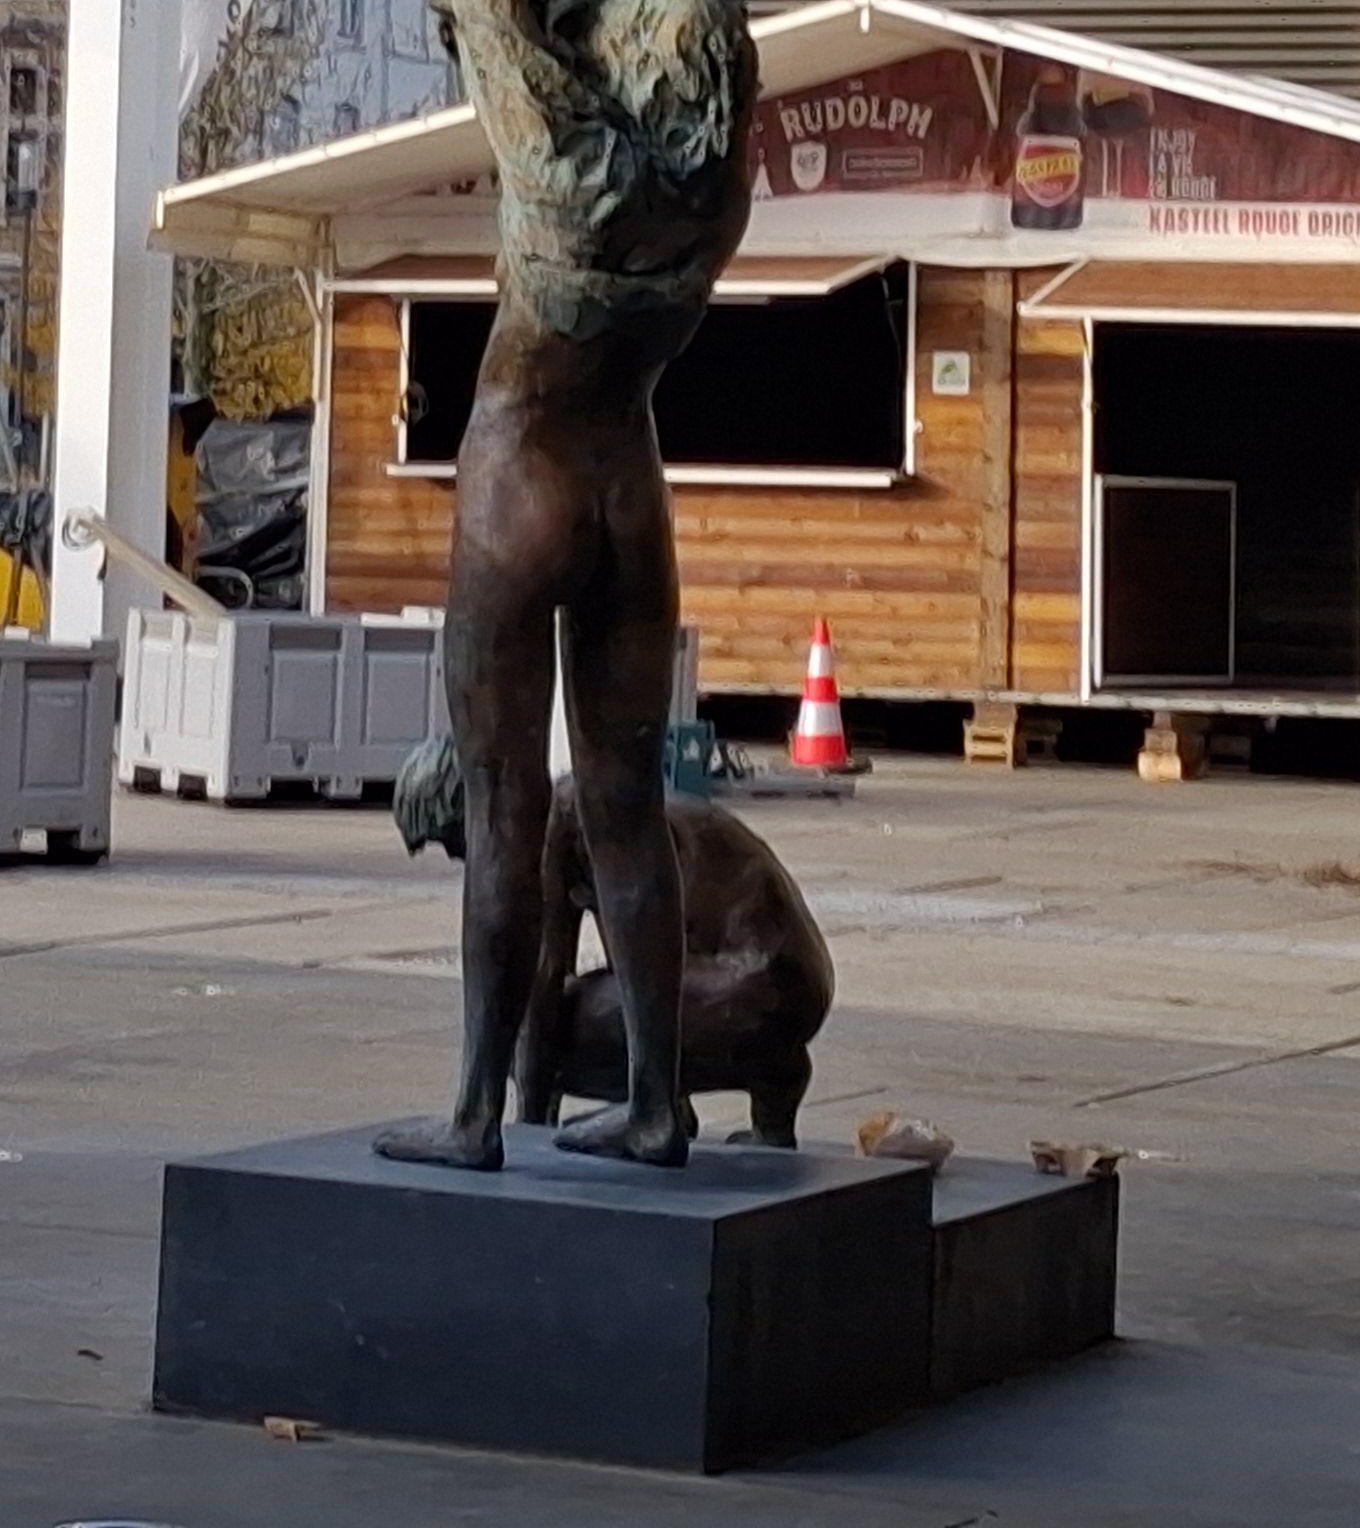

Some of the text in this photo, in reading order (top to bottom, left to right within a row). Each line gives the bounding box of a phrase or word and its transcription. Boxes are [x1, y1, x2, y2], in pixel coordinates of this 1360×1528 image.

[780, 94, 934, 143] RUDOLPH
[1148, 205, 1231, 236] KASTEEL
[1238, 208, 1300, 237] ROUGE
